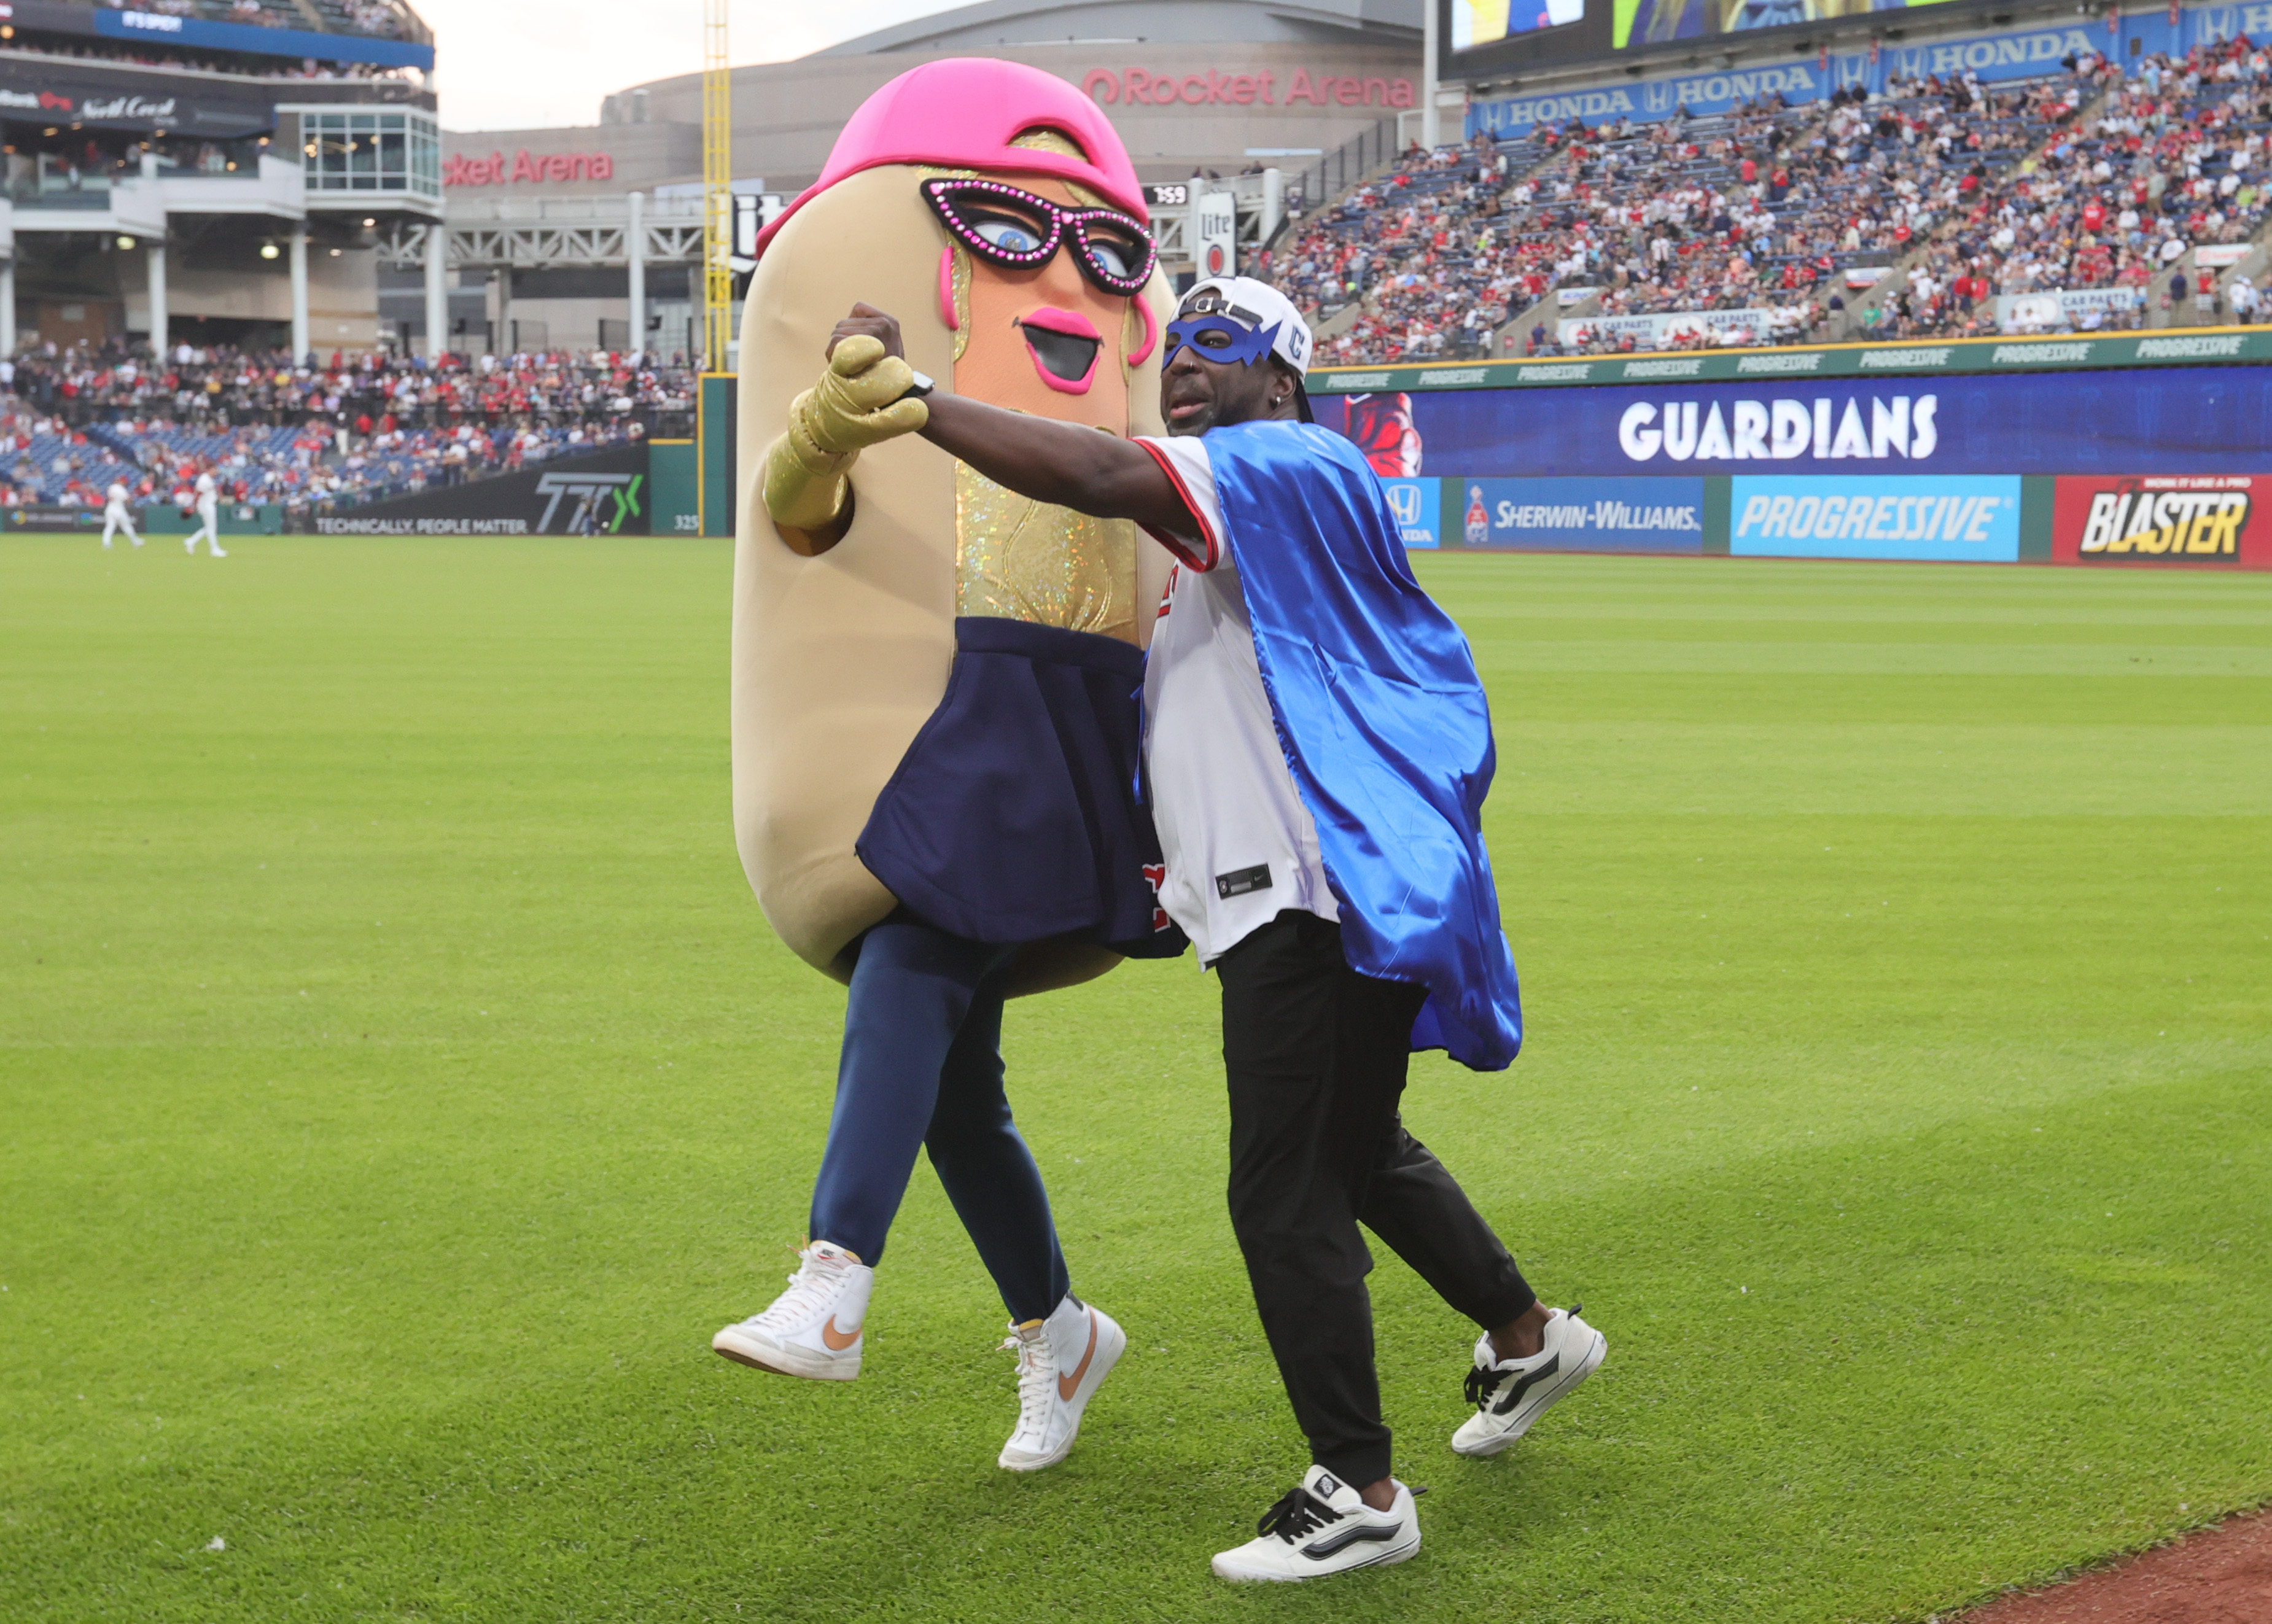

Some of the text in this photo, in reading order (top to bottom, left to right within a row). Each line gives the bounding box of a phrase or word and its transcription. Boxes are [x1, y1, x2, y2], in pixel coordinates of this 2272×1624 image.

[1931, 29, 2096, 74] HONDA
[1123, 66, 1415, 108] Rocket Arena
[1675, 66, 1815, 104] HONDA
[1509, 90, 1635, 125] HONDA
[510, 149, 613, 182] Arena
[1201, 213, 1230, 241] Lite
[1289, 325, 1305, 360] C
[1992, 342, 2091, 363] PROGRESSIVE
[2136, 335, 2244, 359] PROGRESSIVE
[1618, 394, 1938, 461] GUARDIANS
[416, 517, 470, 534] PEOPLE
[2080, 492, 2249, 554] BLASTER
